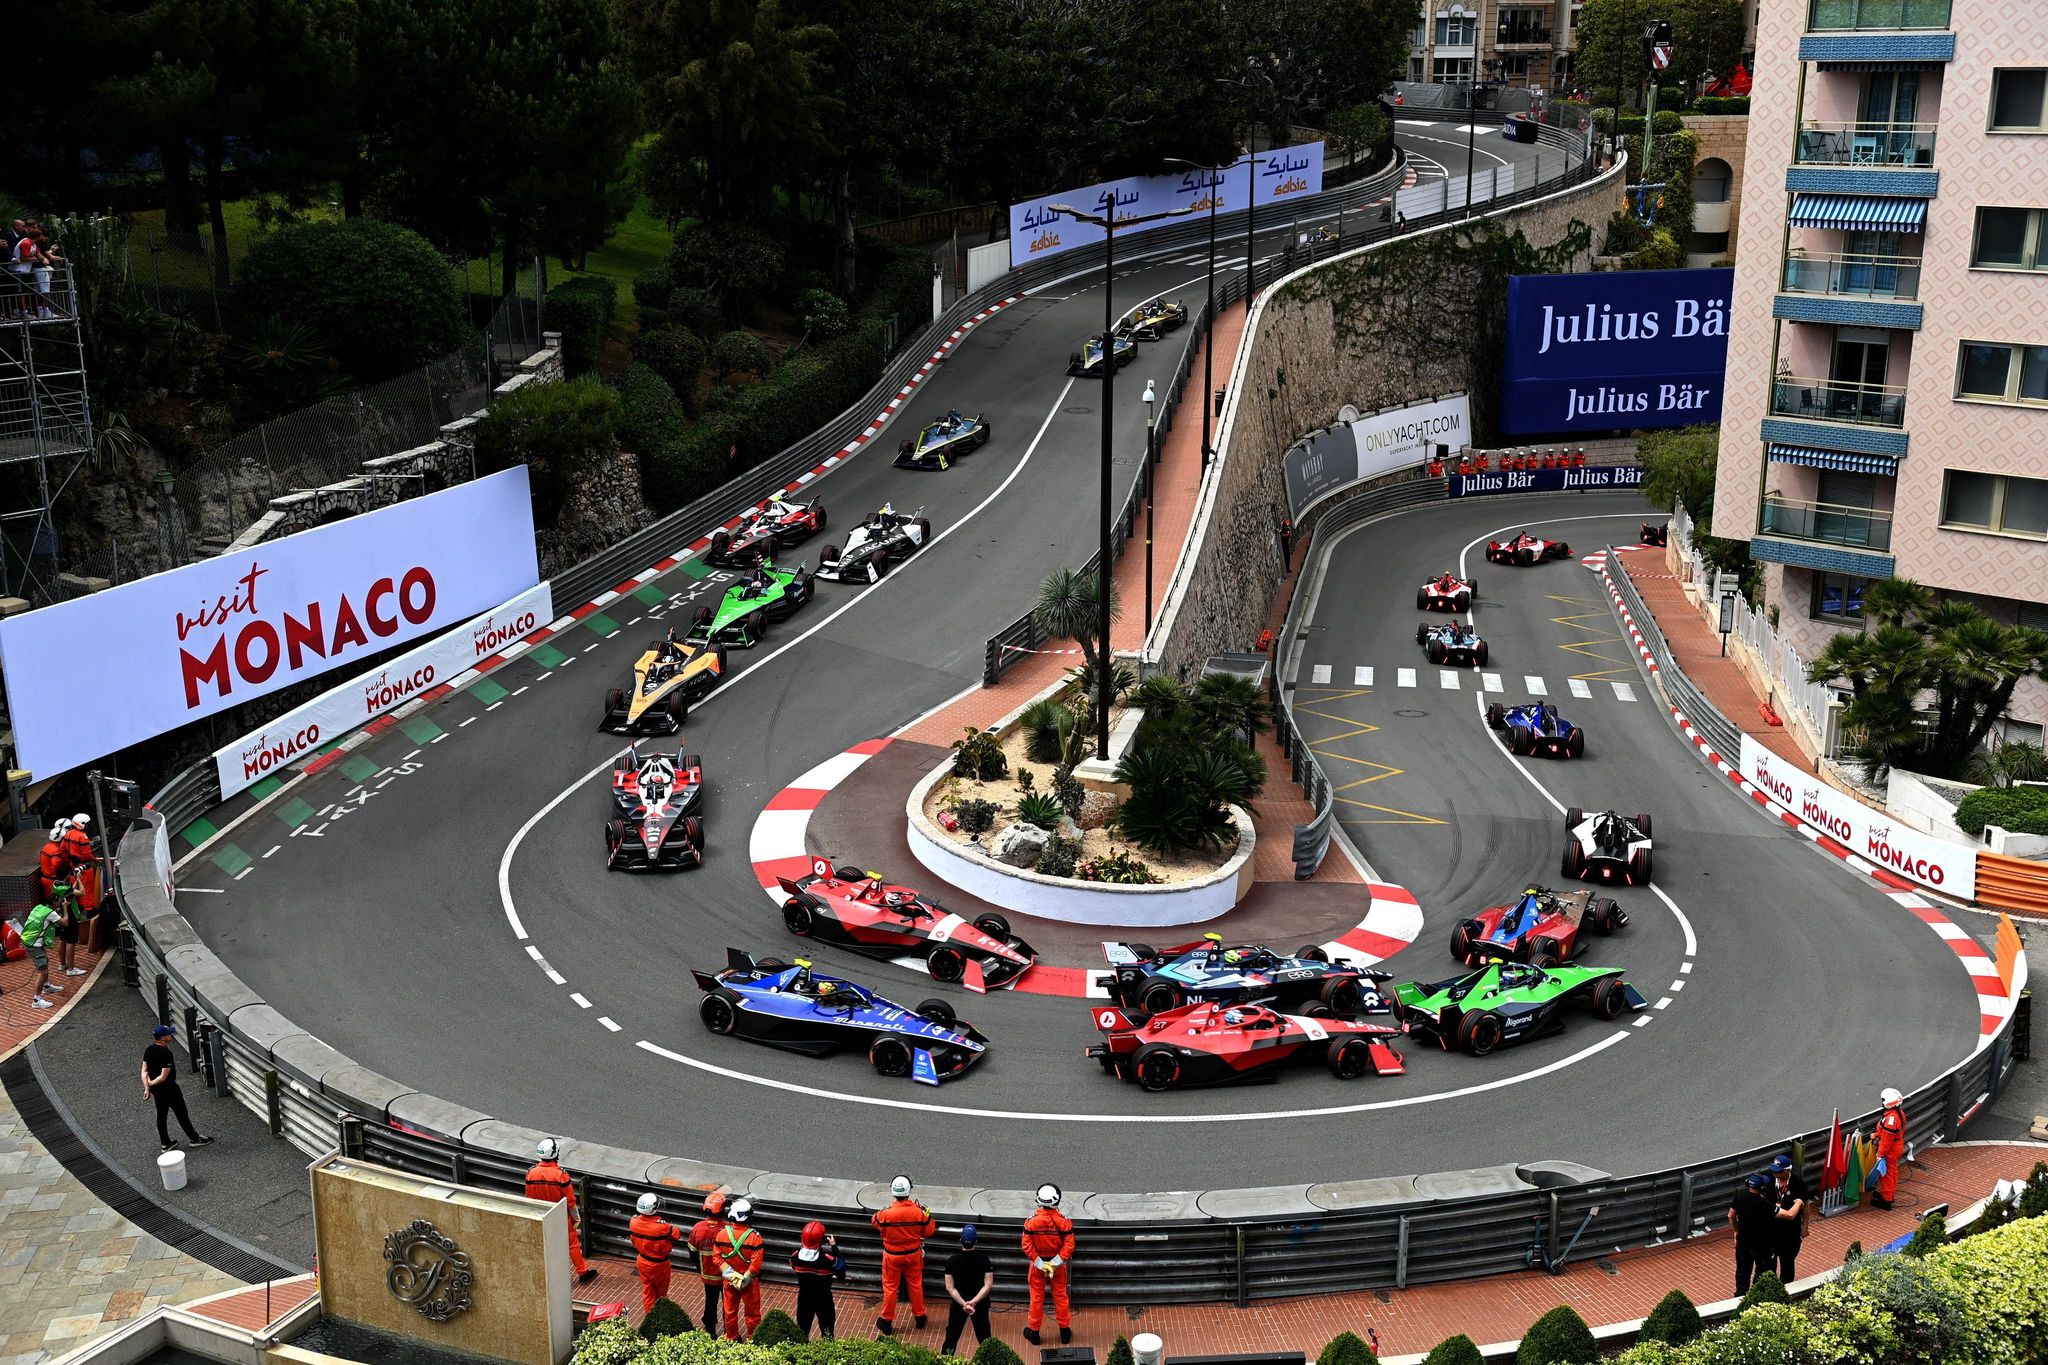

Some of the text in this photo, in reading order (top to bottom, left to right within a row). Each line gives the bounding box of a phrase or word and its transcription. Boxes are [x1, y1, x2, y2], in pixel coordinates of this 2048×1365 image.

[1273, 176, 1308, 196] sabic
[1189, 192, 1225, 212] sabc
[1029, 230, 1061, 253] sabic
[1538, 299, 1731, 354] Julius Bä
[1566, 383, 1710, 421] Julius Bär
[1461, 471, 1536, 496] Julius Bär
[1562, 467, 1644, 490] Julius Bär
[176, 561, 269, 641] visit
[179, 566, 436, 710] MONACO
[474, 616, 494, 639] visit
[475, 612, 535, 656] MONACO
[365, 670, 389, 695] visit
[366, 665, 435, 713] MONACO
[242, 733, 268, 760] visit
[244, 724, 320, 780] MONACO
[302, 762, 424, 836] TAXIS
[1756, 767, 1793, 804] MONACO
[1802, 799, 1852, 841] MONACO
[1869, 825, 1891, 842] visit
[1868, 836, 1944, 885] MONACO
[1157, 957, 1164, 965] 3
[832, 1016, 907, 1031] Maserati
[1153, 1021, 1167, 1029] 27
